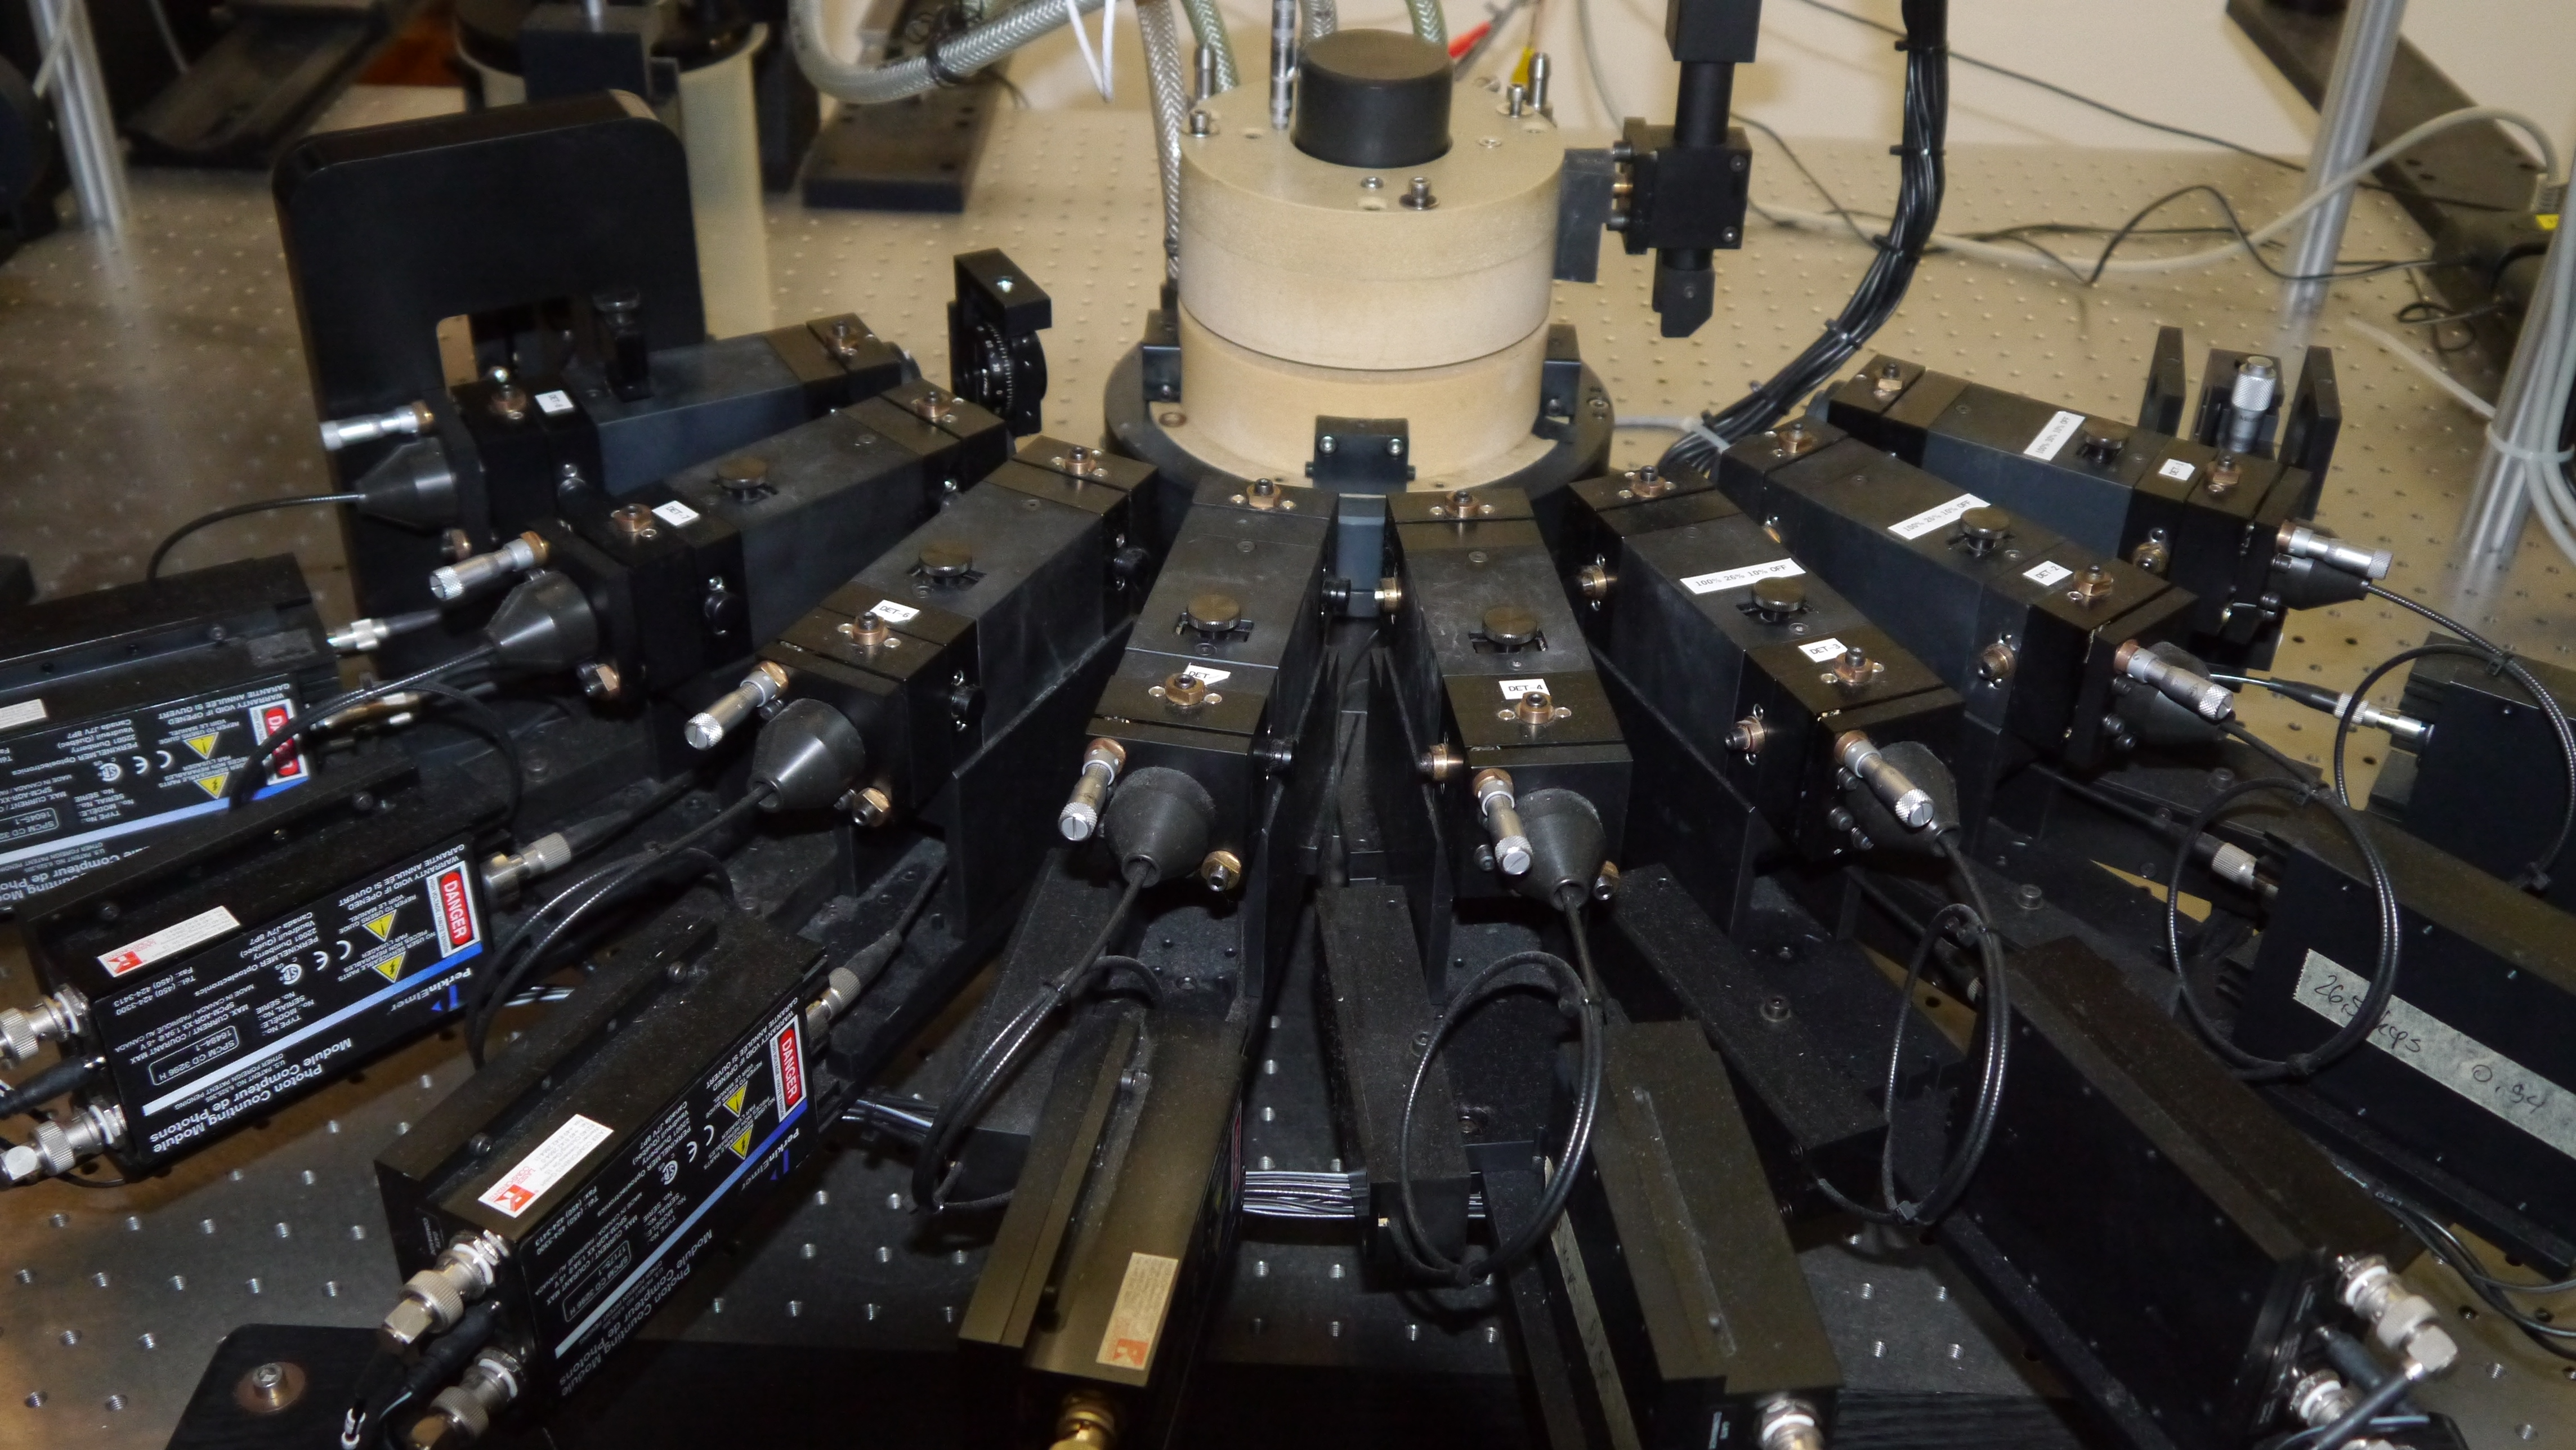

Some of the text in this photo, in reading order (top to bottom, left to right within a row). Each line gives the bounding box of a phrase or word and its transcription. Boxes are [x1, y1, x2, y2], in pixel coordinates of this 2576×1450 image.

[665, 506, 690, 520] DET-7
[1903, 521, 1925, 532] 100%
[1957, 500, 1972, 509] OFF
[1695, 564, 1787, 587] 100% 26% 10% OFF
[2035, 565, 2060, 579] DET-2
[879, 606, 910, 618] DET-6
[1809, 643, 1841, 655] DET-3
[236, 692, 284, 709] WARRANTY
[247, 683, 290, 698] GARANTIE
[156, 705, 193, 719] OUVERT
[167, 711, 203, 724] OPENED
[214, 704, 235, 714] VOID
[9, 820, 53, 837] SPCM CD
[424, 843, 464, 867] GARANTIE
[31, 871, 49, 885] de
[347, 854, 459, 910] WARRANTY VOID IF OPENED
[374, 880, 382, 890] SI
[337, 885, 372, 906] OUVERT
[444, 879, 467, 939] DANGER
[239, 919, 315, 959] Vaudreuil (Québec)
[248, 911, 313, 945] Canada J7V 8P7
[252, 927, 317, 961] 22001 Dumberry
[193, 935, 318, 998] PERKINELMER Optoelectronics
[113, 965, 193, 1007] Fax: (450) 424-3413
[154, 982, 176, 999] (450)
[225, 993, 233, 1002] IN
[234, 983, 254, 997] MADE
[390, 965, 472, 1014] PerkinElmer
[115, 992, 153, 1015] 424-3300
[196, 997, 225, 1015] CANADA
[229, 1003, 248, 1017] MAX.
[255, 990, 294, 1015] No. SÉRIE
[275, 993, 305, 1014] SERIAL
[768, 996, 798, 1030] GARANTIE
[145, 1029, 155, 1039] AU
[156, 1012, 192, 1035] FABRIQUÉ
[191, 1012, 228, 1035] CURRENT
[114, 1034, 145, 1054] CANADA
[149, 1032, 186, 1055] COURANT
[712, 1010, 793, 1091] WARRANTY VOID IF OPENED
[129, 1050, 147, 1064] MAX
[158, 1038, 235, 1081] SPCM CD 3296 H
[732, 1053, 737, 1064] SI
[782, 1036, 797, 1100] DANGER
[705, 1059, 731, 1089] OUVERT
[149, 1036, 351, 1146] Module Compteur de Photons
[152, 1062, 322, 1156] Photon Counting Module
[638, 1099, 687, 1150] Canada J7V 8P7
[740, 1125, 800, 1193] PerkinElmer
[596, 1124, 690, 1219] PERKINELMER Optoelectronics
[569, 1254, 627, 1317] SPCM CD 3296 H
[559, 1227, 712, 1391] Module Compteur de Photons
[561, 1261, 690, 1402] Photon Counting Module
